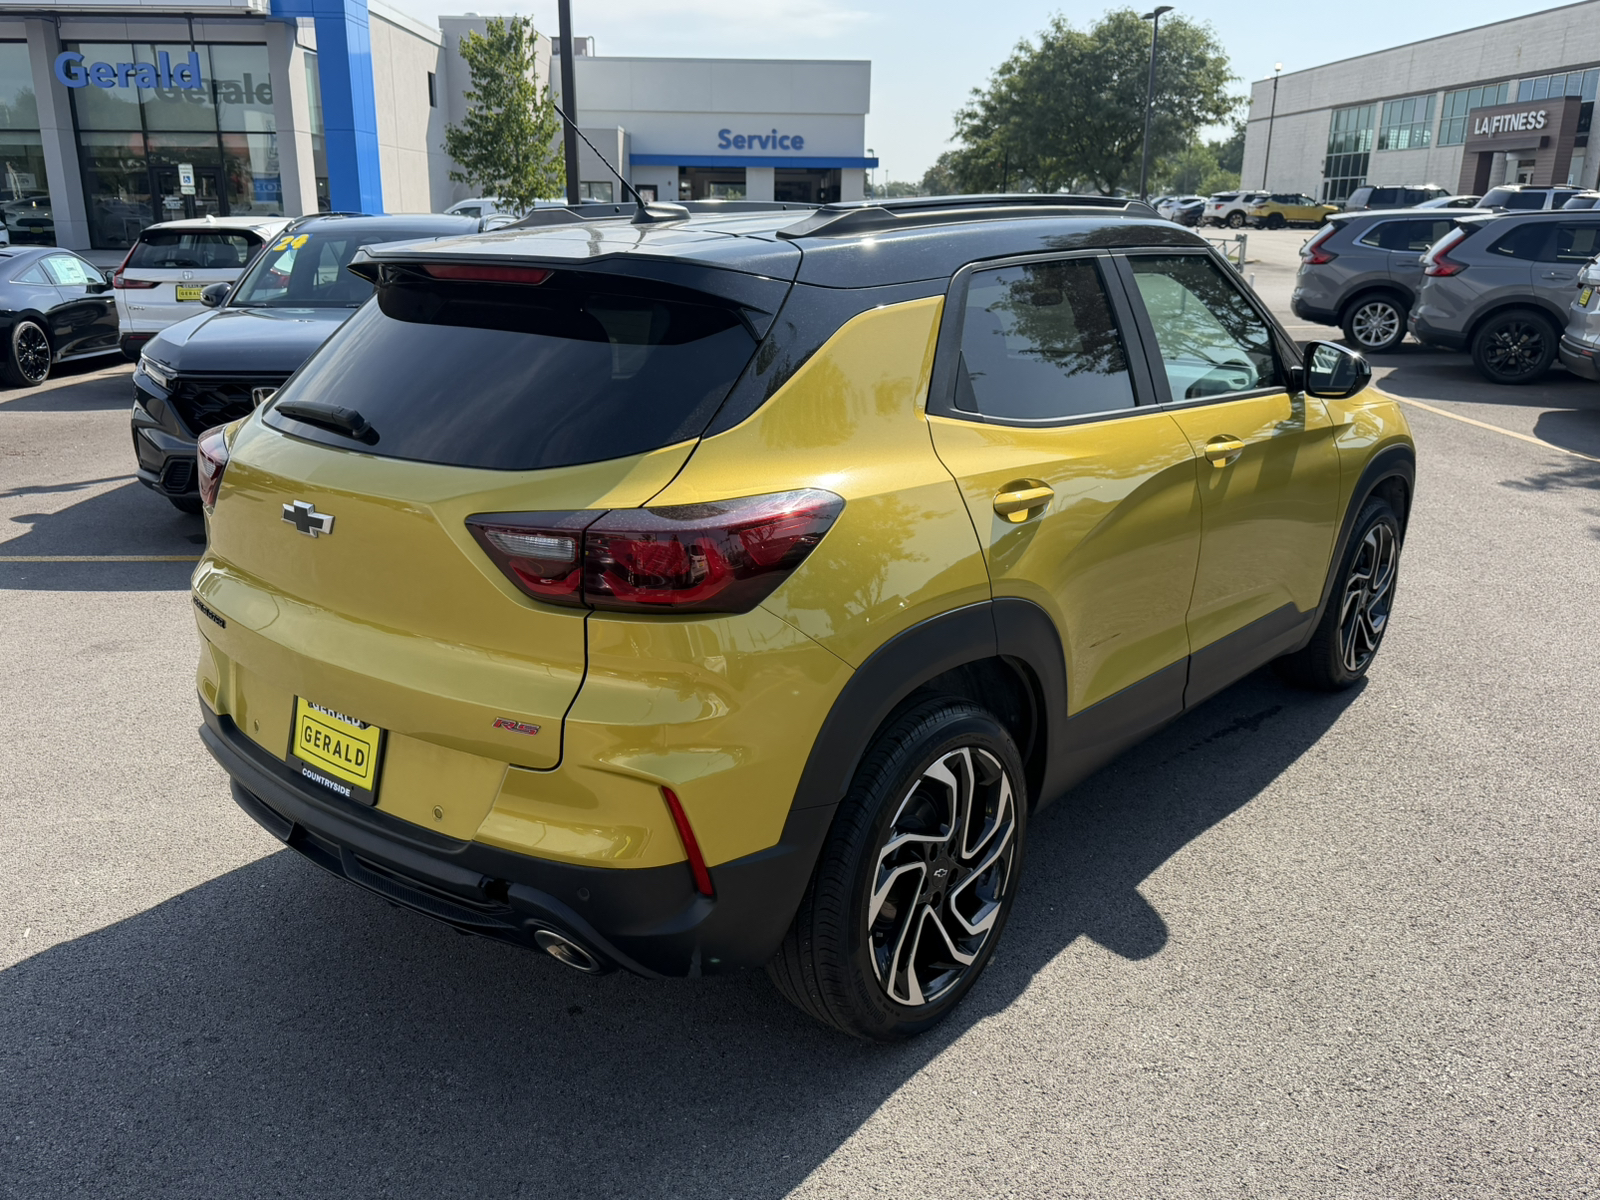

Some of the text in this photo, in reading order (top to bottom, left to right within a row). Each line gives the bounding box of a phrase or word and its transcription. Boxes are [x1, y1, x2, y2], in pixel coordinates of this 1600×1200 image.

[54, 50, 202, 89] Gerald
[1474, 110, 1547, 134] LA FITNESS
[718, 128, 804, 151] Service
[272, 233, 310, 251] 24
[492, 717, 540, 736] RS
[303, 725, 365, 767] GERALD
[302, 767, 351, 797] COUNTRYSIDE
